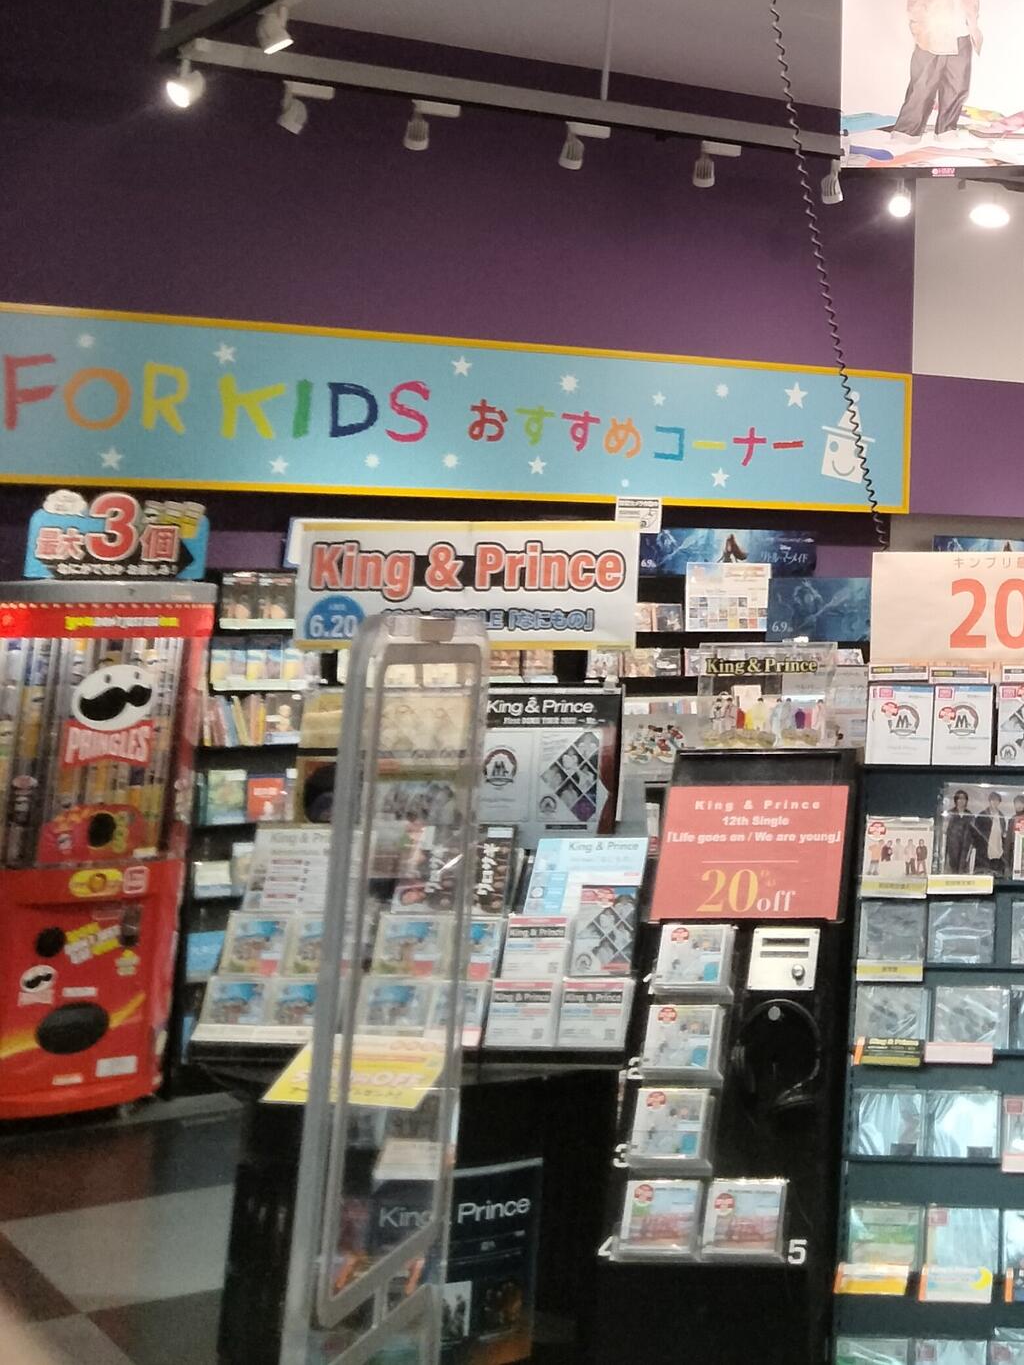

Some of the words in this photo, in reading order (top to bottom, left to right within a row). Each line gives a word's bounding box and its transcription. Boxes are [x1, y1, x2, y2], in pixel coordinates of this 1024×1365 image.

[3, 354, 190, 434] FOR
[218, 373, 431, 443] KIDS
[468, 398, 804, 466] おすすめコーナー
[311, 541, 415, 601] King
[425, 542, 463, 590] &
[475, 541, 626, 592] Prince
[771, 621, 788, 633] 6.9
[705, 658, 745, 675] King
[747, 657, 763, 673] &
[765, 657, 817, 673] Prince
[486, 699, 523, 716] King
[525, 697, 540, 714] &
[542, 699, 595, 714] Prince
[695, 800, 734, 812] King
[744, 800, 753, 810] &
[764, 799, 821, 810] Prince
[722, 816, 749, 826] 12th
[752, 816, 790, 828] Single
[569, 841, 593, 853] King
[595, 841, 604, 852] &
[606, 841, 639, 852] Prince
[698, 833, 726, 844] goes
[755, 832, 773, 842] We
[776, 833, 795, 842] are
[696, 868, 759, 913] 20
[756, 890, 796, 912] off
[457, 1197, 532, 1224] Prince
[787, 1239, 807, 1264] 5
